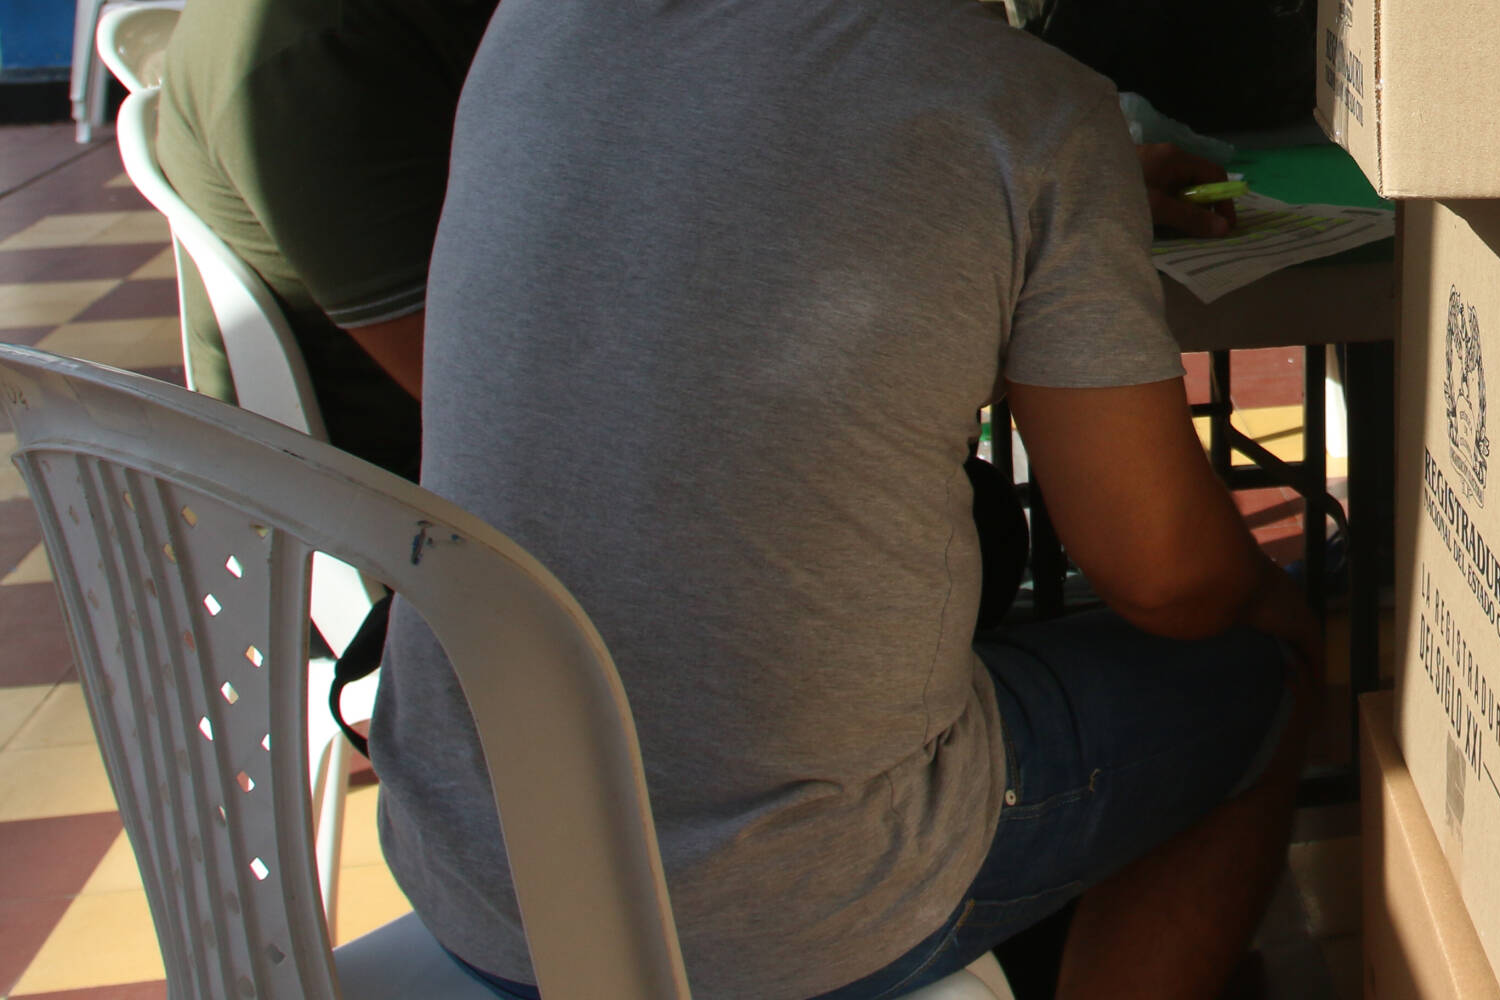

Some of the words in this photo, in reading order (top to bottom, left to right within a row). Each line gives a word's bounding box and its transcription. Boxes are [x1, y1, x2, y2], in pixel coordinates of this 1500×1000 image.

[1421, 560, 1431, 609] LA
[1453, 538, 1467, 577] DEL
[1468, 562, 1495, 625] ESTADO
[1464, 703, 1482, 782] XXI
